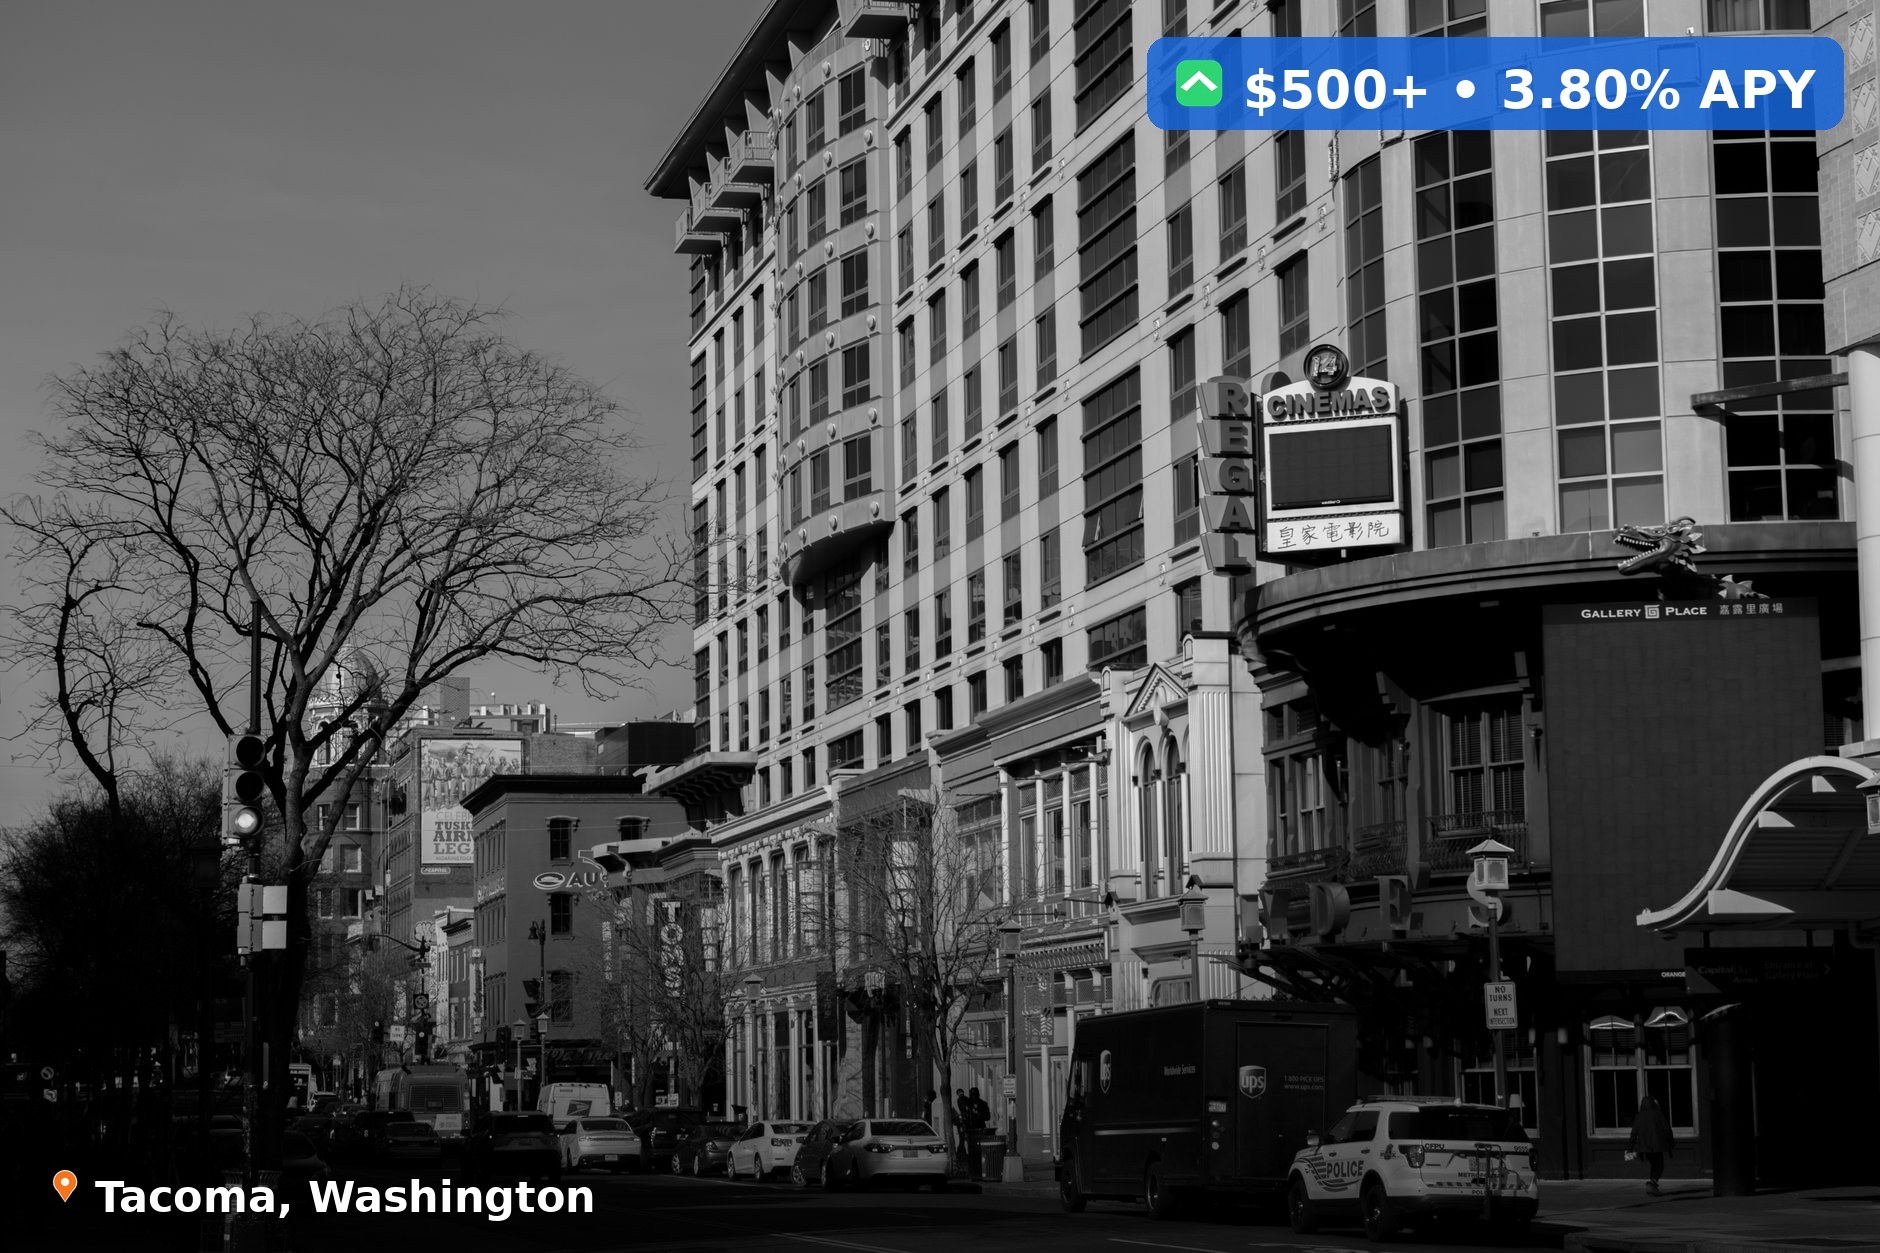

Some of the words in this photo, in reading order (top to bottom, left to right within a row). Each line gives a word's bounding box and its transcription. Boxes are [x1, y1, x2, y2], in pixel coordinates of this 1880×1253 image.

[1266, 386, 1391, 421] CINEMAS
[1217, 381, 1255, 570] REGAL
[1277, 519, 1390, 550] 皇家電影院
[1580, 607, 1642, 619] GALLERY
[1665, 605, 1708, 616] PLACE
[434, 821, 473, 830] TUSK
[433, 842, 474, 855] LEG
[1494, 985, 1506, 994] NO
[1489, 994, 1513, 1002] TURNS
[1493, 1008, 1508, 1016] NEXT
[1241, 1077, 1265, 1093] ups
[1326, 1160, 1364, 1178] POLICE
